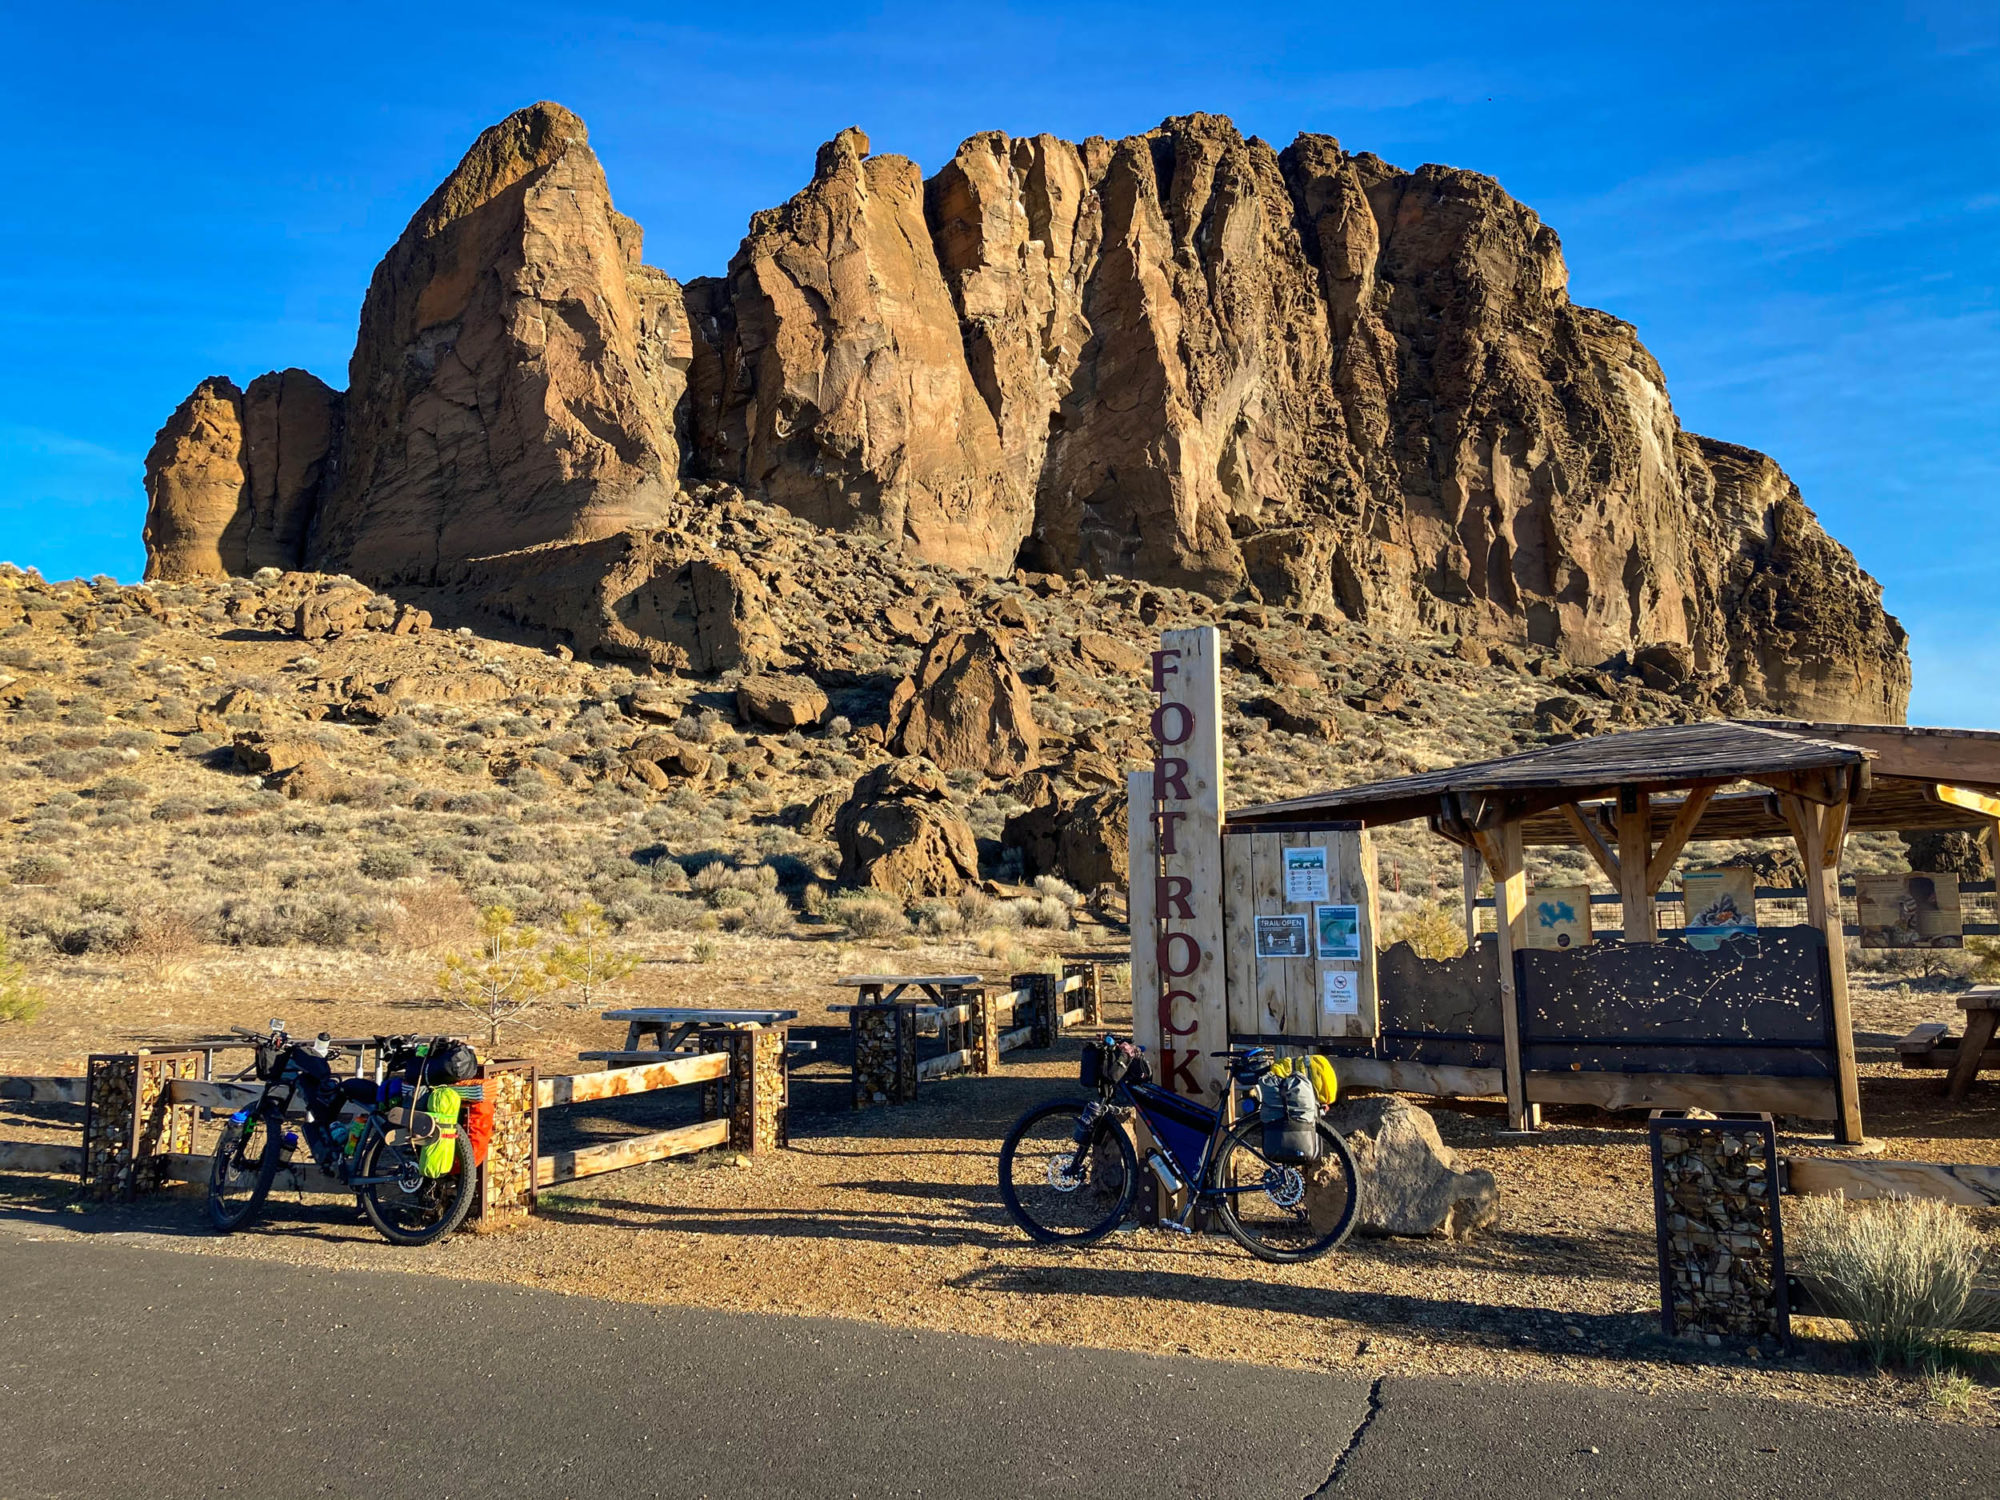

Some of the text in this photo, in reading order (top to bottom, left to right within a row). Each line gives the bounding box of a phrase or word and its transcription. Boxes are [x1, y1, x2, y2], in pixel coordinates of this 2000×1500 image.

[1150, 649, 1194, 855] FORT
[1157, 876, 1203, 1094] ROCK
[1261, 919, 1302, 927] TRAIL OPEN
